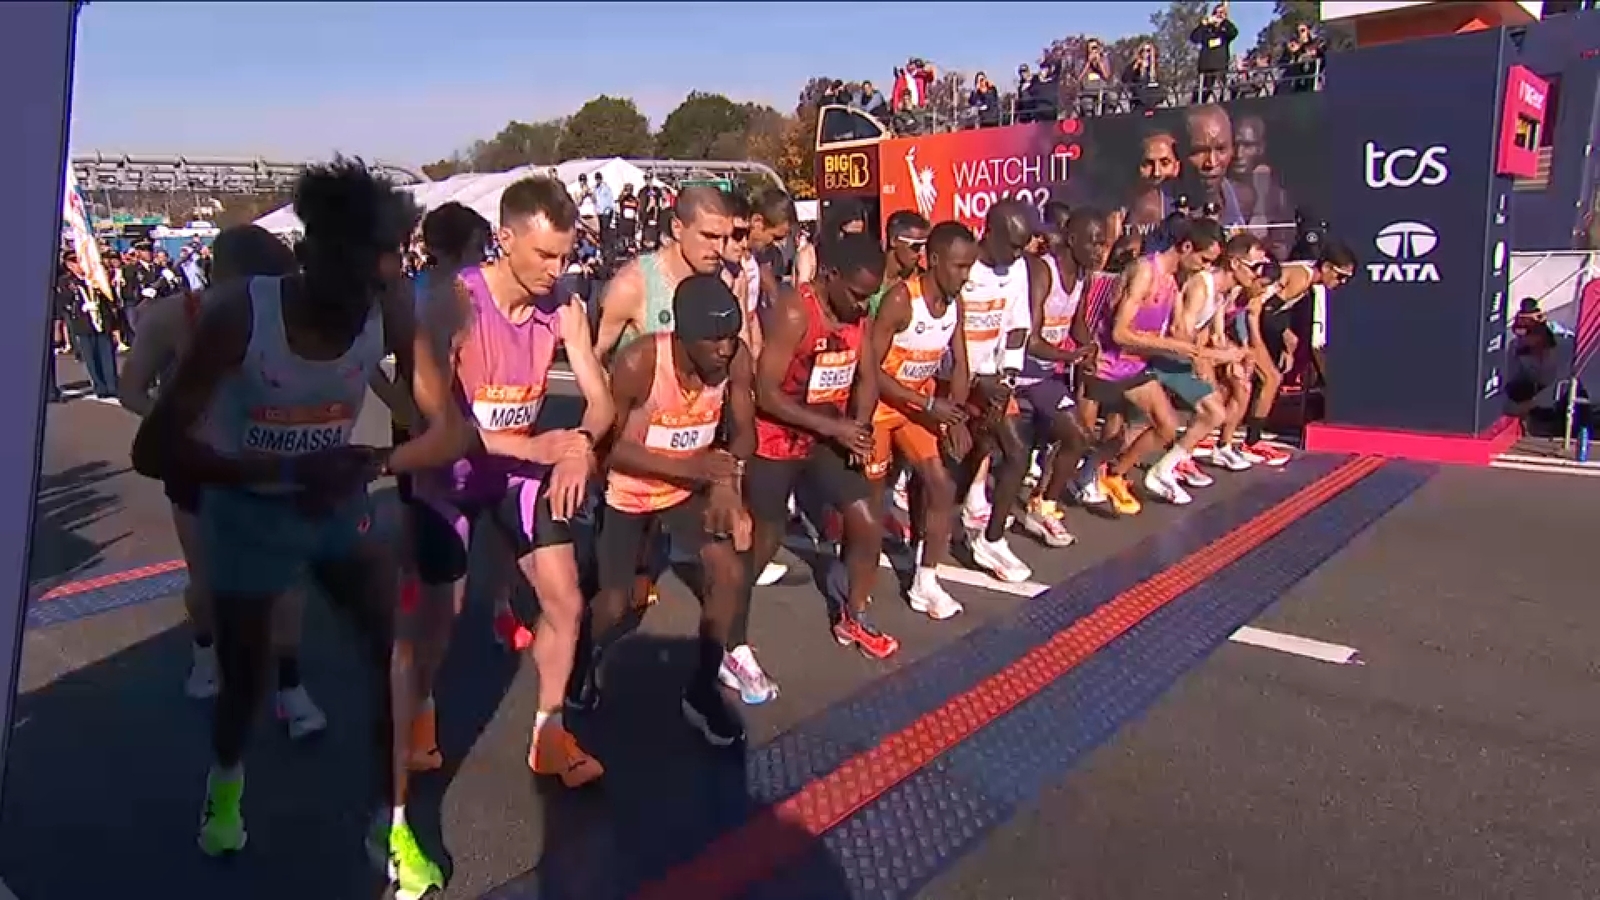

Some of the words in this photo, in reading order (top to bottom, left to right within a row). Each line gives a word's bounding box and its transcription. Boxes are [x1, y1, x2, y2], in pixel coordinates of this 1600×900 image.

[824, 154, 848, 173] BIG
[952, 154, 1041, 188] WATCH
[1050, 152, 1074, 181] IT
[1366, 141, 1447, 187] tcs
[824, 173, 849, 189] BUS
[1366, 263, 1441, 282] TATA
[490, 404, 535, 427] MOEN
[246, 425, 343, 452] SIMBASSA
[670, 430, 699, 448] BOR
